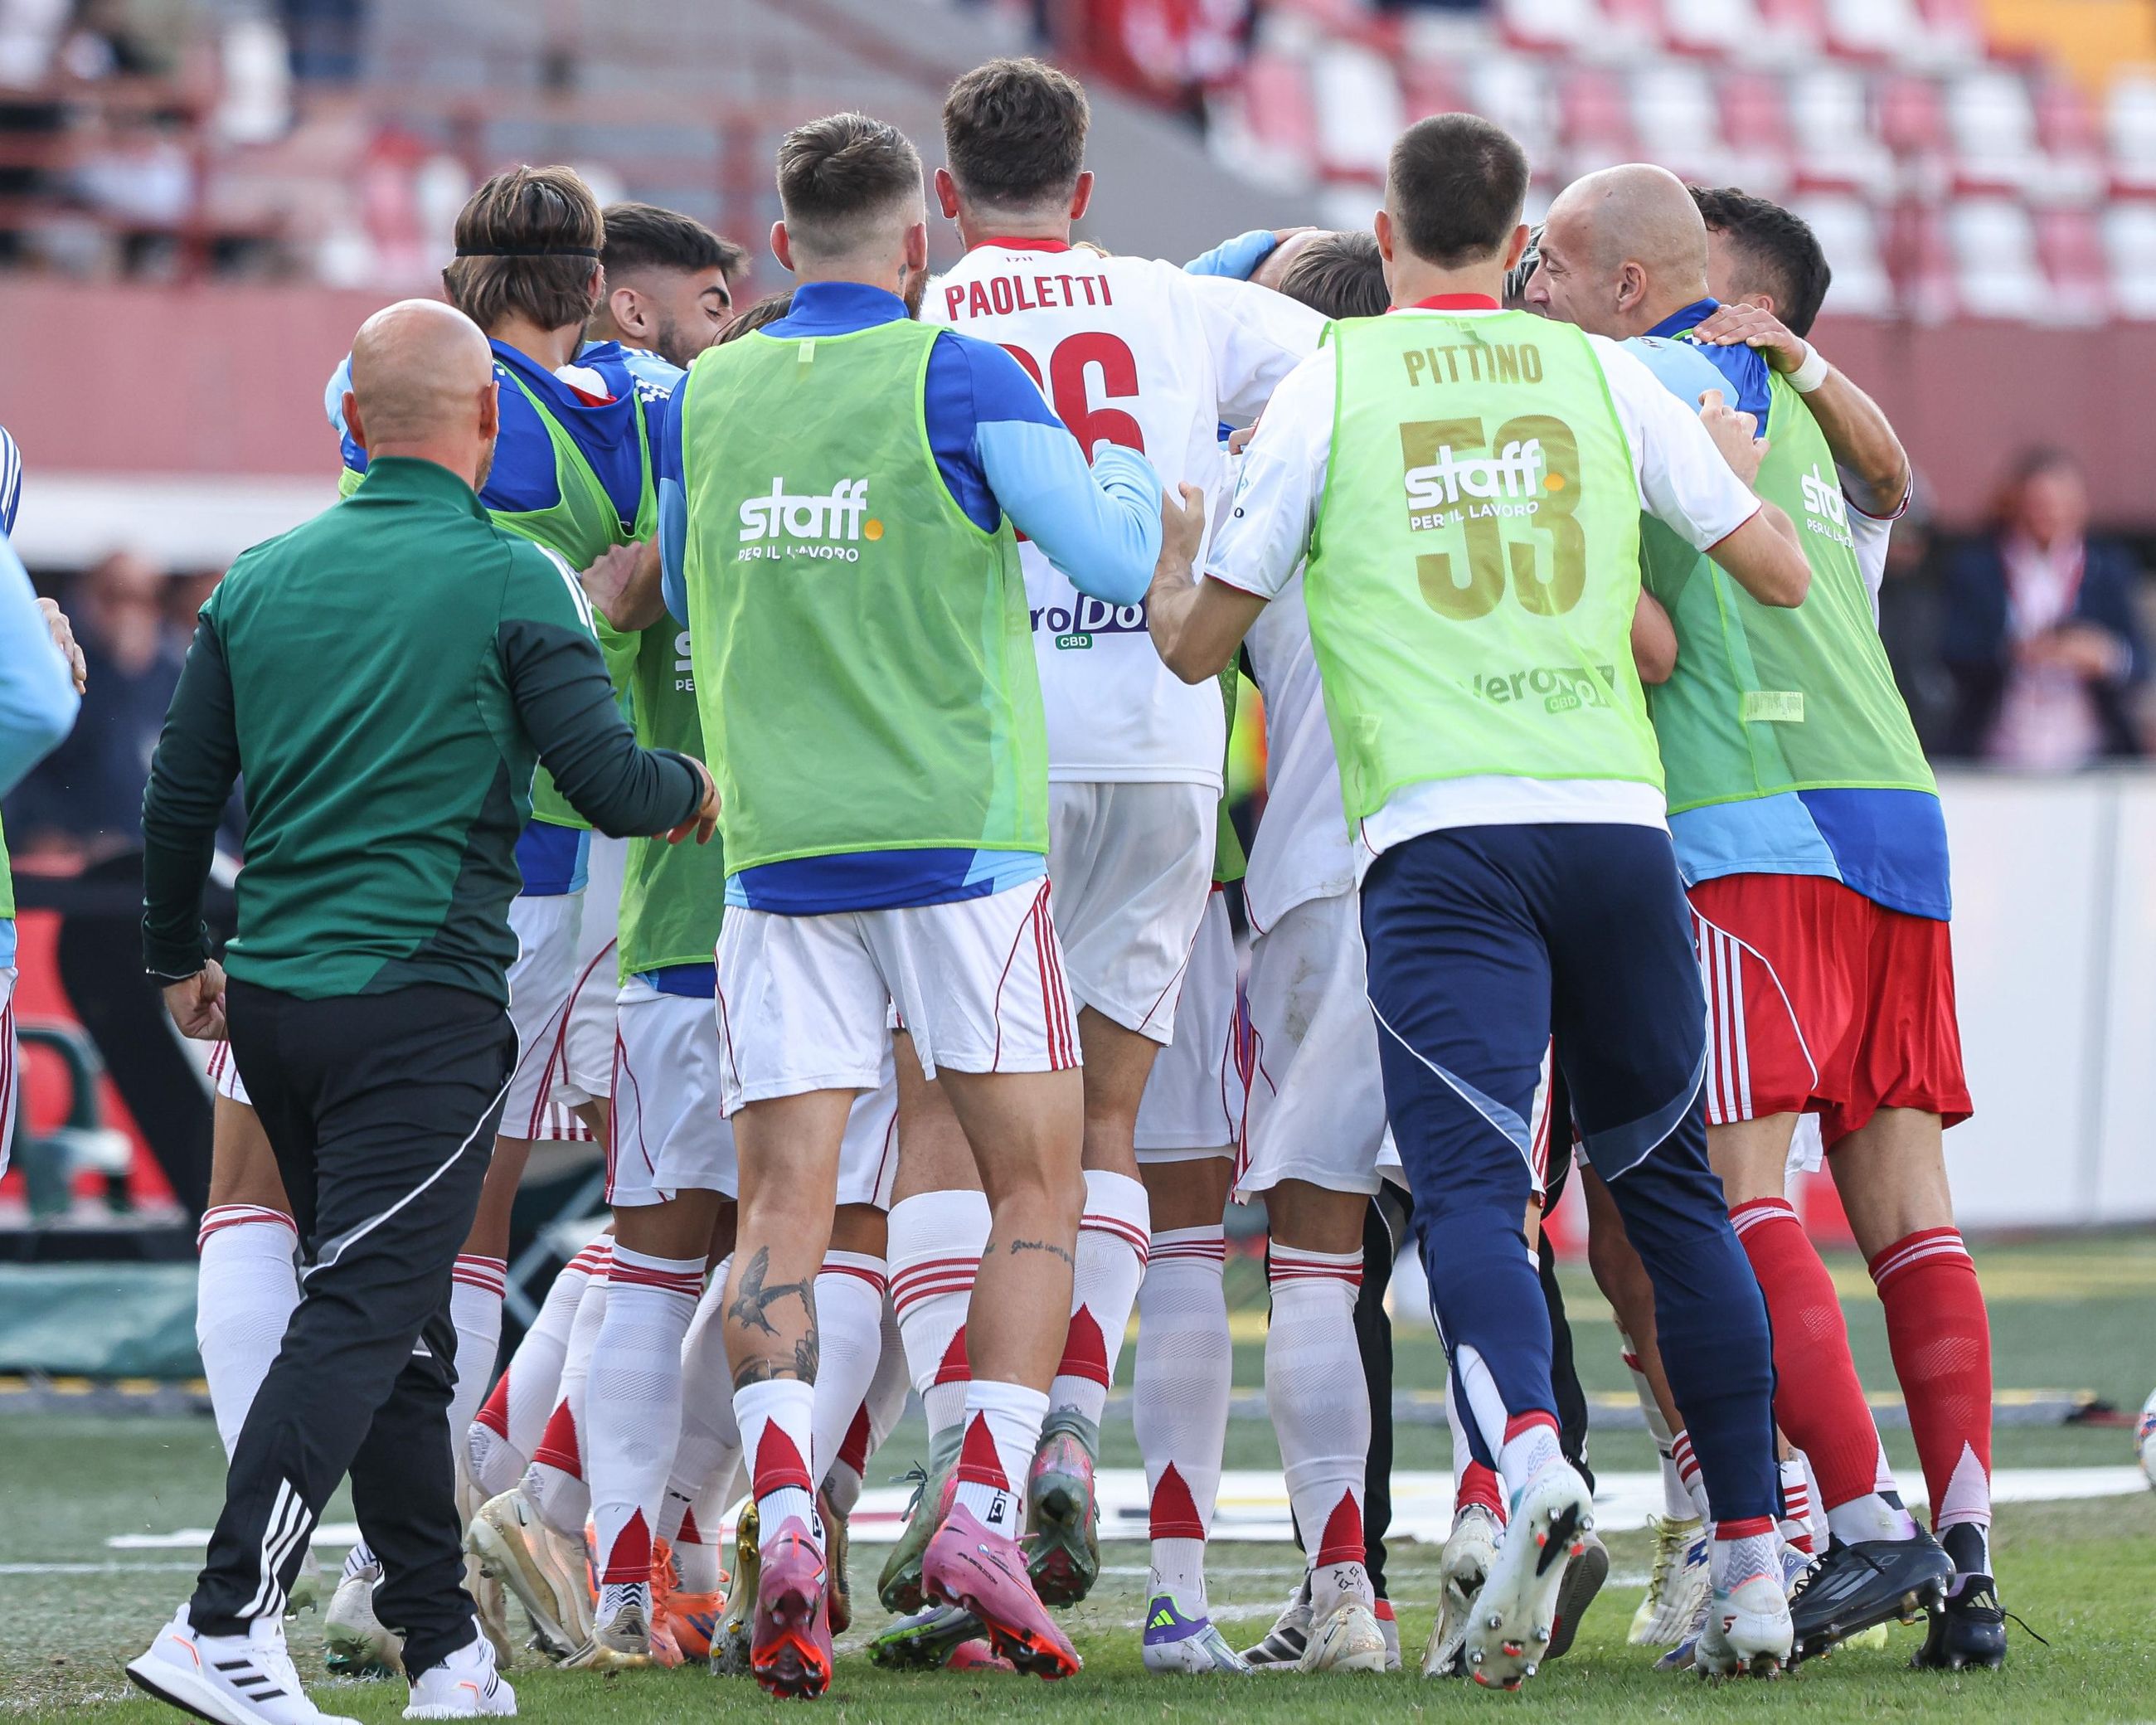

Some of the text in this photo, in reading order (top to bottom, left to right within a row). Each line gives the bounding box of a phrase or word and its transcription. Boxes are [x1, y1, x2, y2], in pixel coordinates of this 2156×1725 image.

[944, 275, 1113, 321] PAOLETTI
[1403, 343, 1543, 386] PITTINO
[1399, 414, 1587, 622] 53
[1411, 501, 1540, 531] PER IL LAVORO
[738, 546, 762, 561] PER
[766, 545, 781, 560] IL
[1060, 637, 1088, 648] CBD
[1549, 695, 1578, 710] CBD
